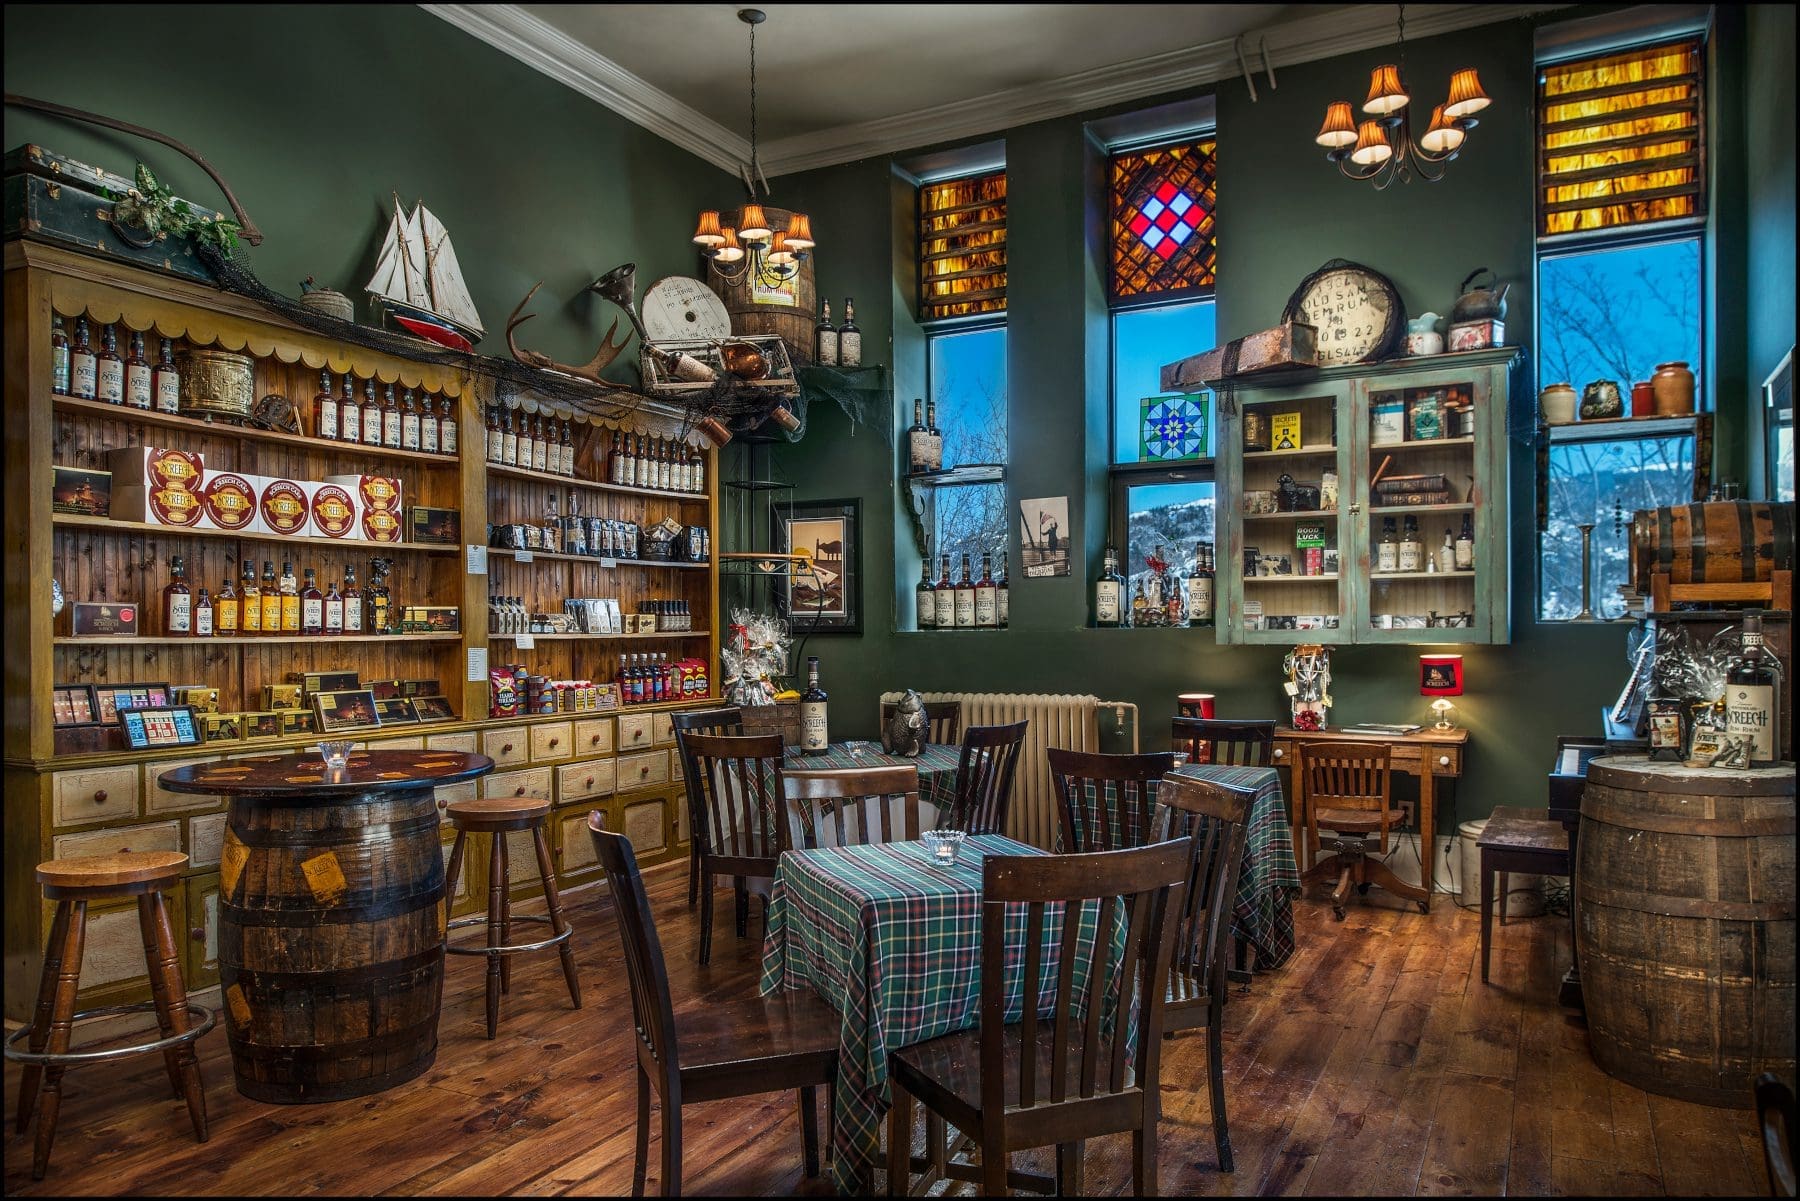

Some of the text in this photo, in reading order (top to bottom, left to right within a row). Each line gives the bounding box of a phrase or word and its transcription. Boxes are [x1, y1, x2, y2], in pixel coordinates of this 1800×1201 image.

[1303, 285, 1366, 310] OLD SAM
[1337, 297, 1369, 313] RUM
[160, 460, 190, 478] SCREECH
[162, 491, 193, 509] SCREECH
[216, 492, 244, 508] SCREECH
[272, 499, 299, 515] SCREECH
[1727, 710, 1768, 727] SCREECH
